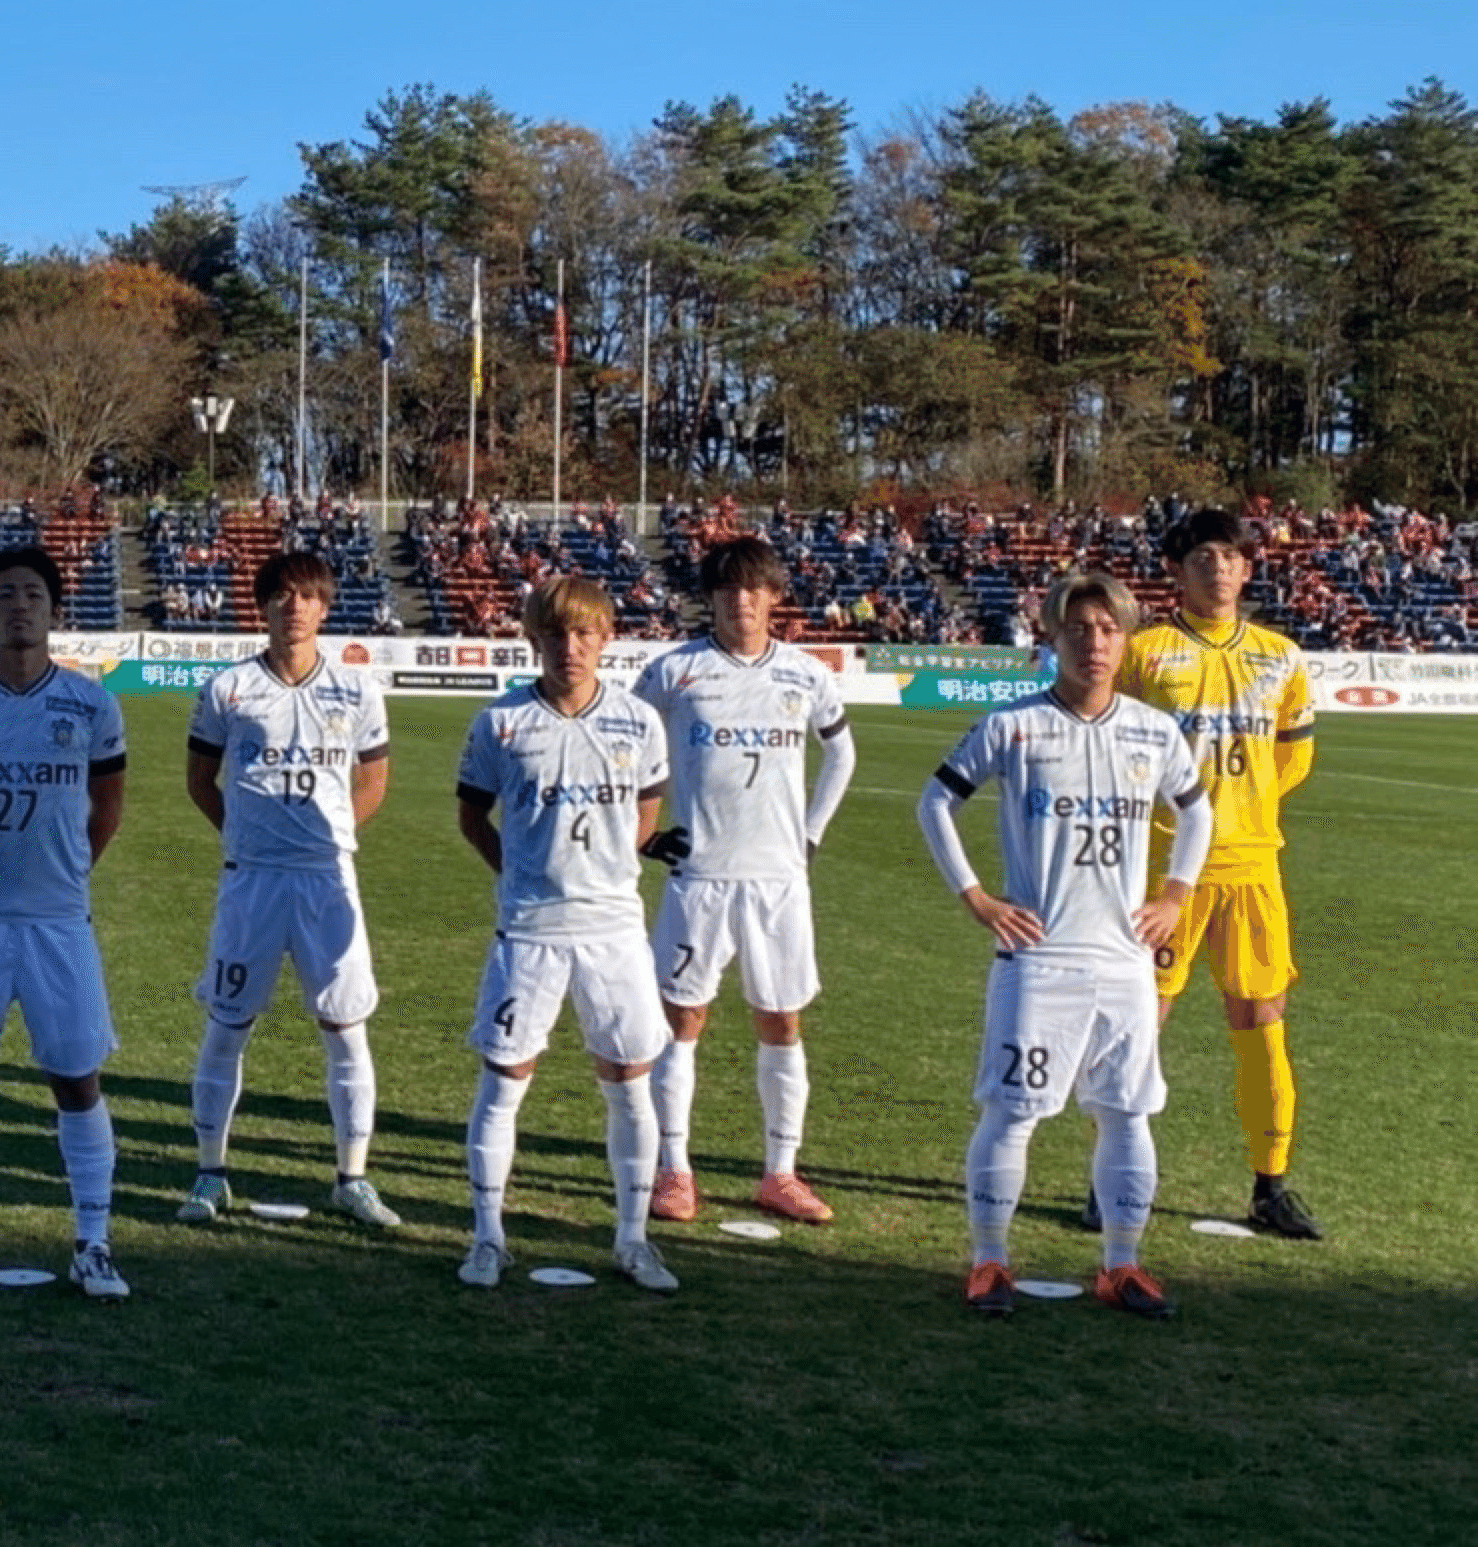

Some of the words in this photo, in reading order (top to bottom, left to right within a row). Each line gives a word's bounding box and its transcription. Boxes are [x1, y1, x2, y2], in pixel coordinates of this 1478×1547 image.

[140, 664, 230, 688] 明治安
[239, 740, 347, 766] Rexxam
[742, 751, 762, 790] 7
[1211, 739, 1247, 777] 16
[281, 769, 316, 806] 19
[1027, 787, 1151, 821] Rexxam
[569, 810, 591, 851] 4
[1073, 823, 1123, 868] 28
[215, 959, 248, 999] 19
[673, 943, 694, 979] 7
[493, 997, 515, 1037] 4
[1002, 1043, 1049, 1089] 28
